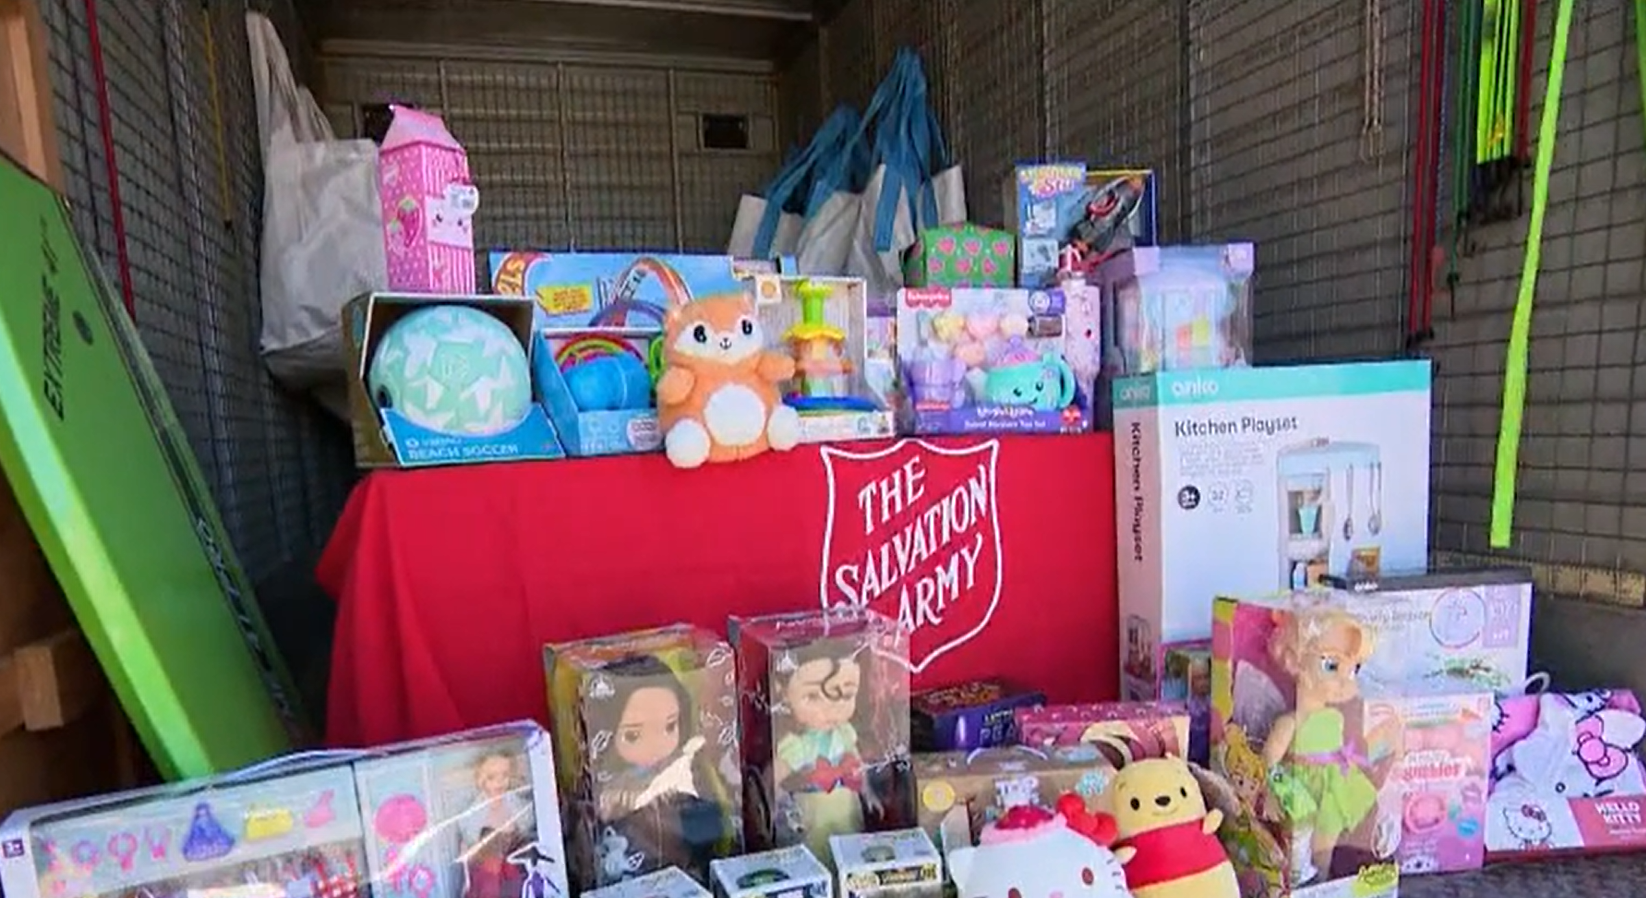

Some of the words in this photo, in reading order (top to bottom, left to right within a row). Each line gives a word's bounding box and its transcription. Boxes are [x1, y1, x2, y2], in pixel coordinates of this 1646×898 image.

[42, 276, 64, 422] EXTREME
[1172, 377, 1218, 396] anko
[1175, 419, 1238, 437] Kitchen
[1241, 416, 1299, 436] Playset
[408, 447, 460, 460] BEACH
[462, 444, 519, 457] SOCCER
[858, 456, 925, 535] THE
[835, 465, 987, 617] SALVATION
[894, 533, 983, 647] ARMY
[1594, 801, 1640, 816] HELLO
[1603, 814, 1641, 825] KITTY
